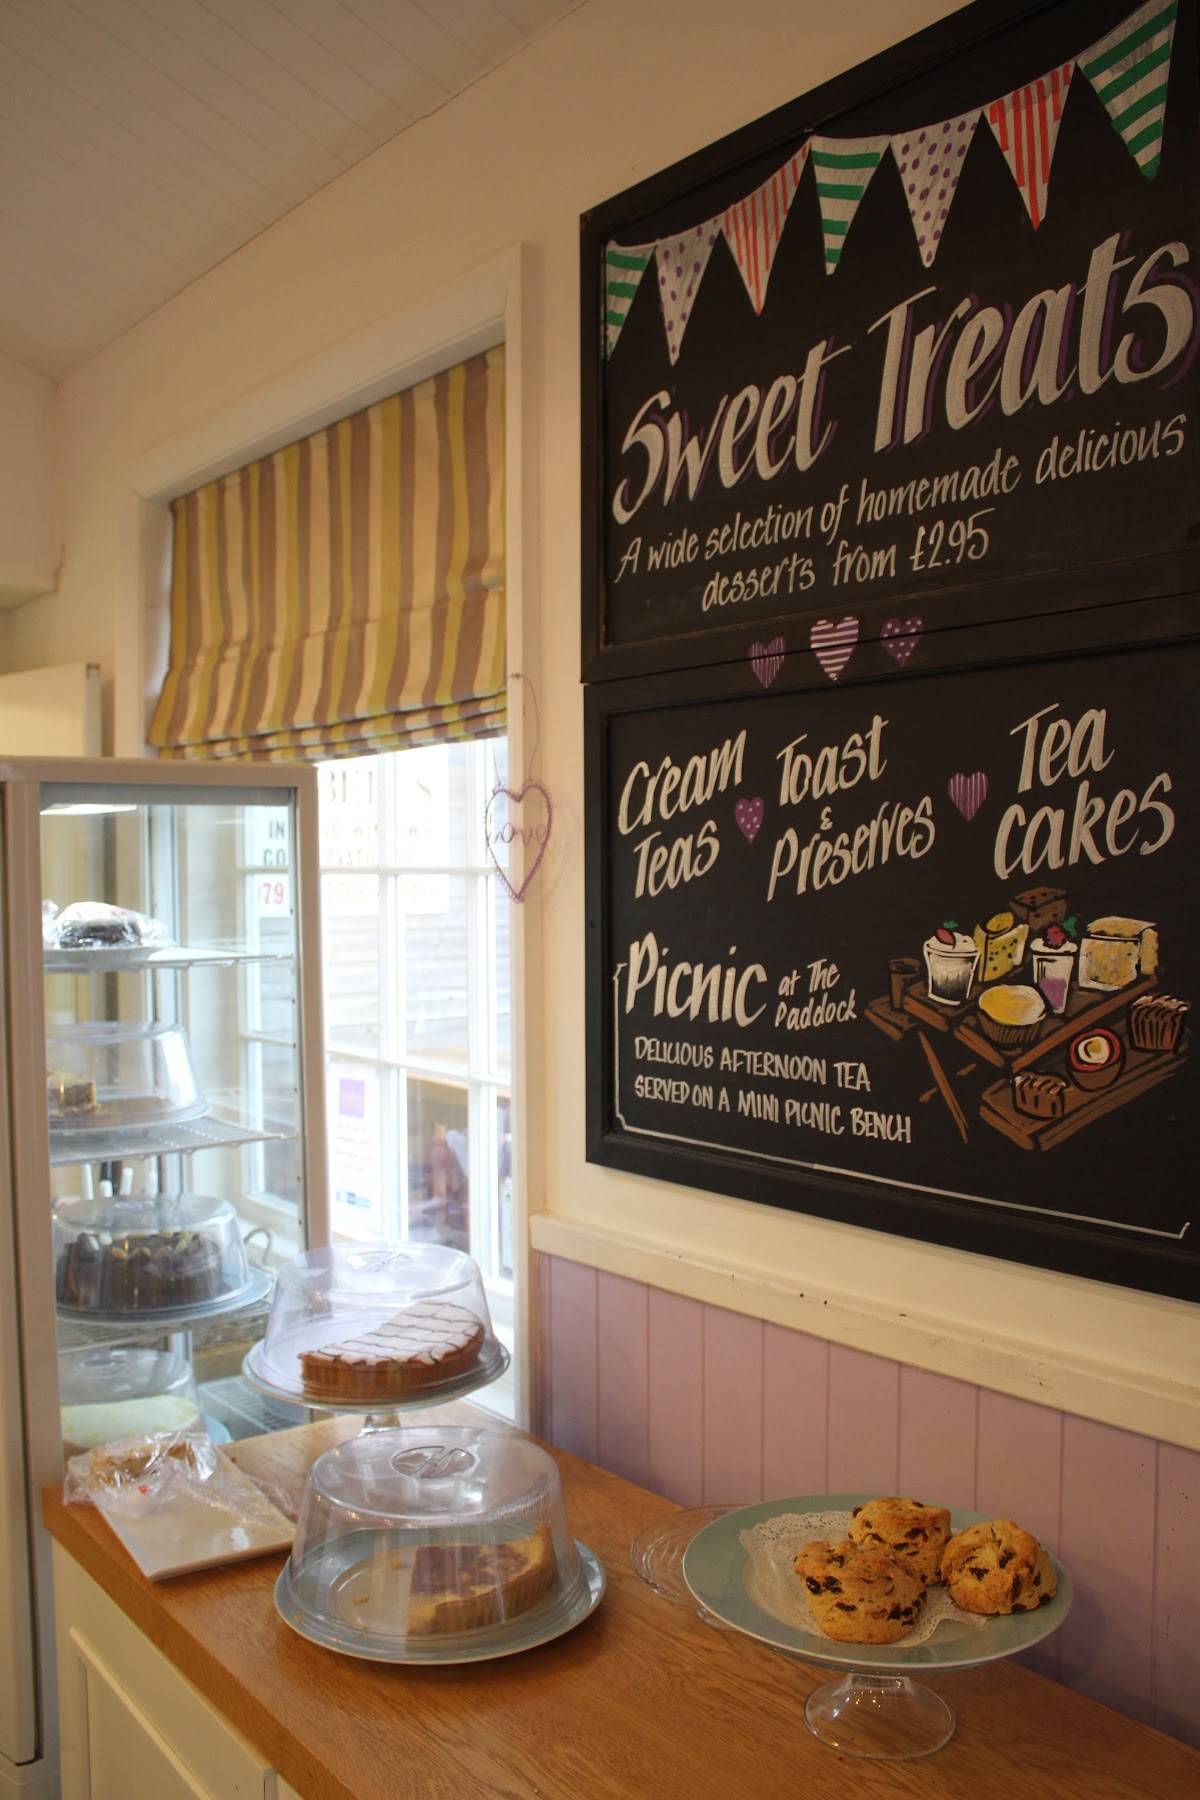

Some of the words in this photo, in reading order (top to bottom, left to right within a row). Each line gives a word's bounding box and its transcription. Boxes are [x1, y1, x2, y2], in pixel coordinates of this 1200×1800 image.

[612, 338, 852, 525] Sweet
[867, 232, 1194, 454] Treats
[614, 536, 642, 583] A
[647, 527, 700, 572] wide
[704, 504, 814, 562] selection
[820, 484, 850, 546] of
[856, 447, 1023, 526] homemade
[1035, 413, 1187, 485] delicious
[702, 552, 816, 612] desserts
[832, 539, 897, 587] from
[909, 507, 997, 573] £2.95
[617, 729, 747, 836] Cream
[775, 714, 890, 807] Toast
[1009, 702, 1116, 794] Tea
[633, 819, 721, 899] Teas
[766, 795, 937, 902] Preserves
[625, 931, 769, 1029] Picnic
[774, 988, 858, 1031] Paddock
[778, 969, 802, 997] at
[806, 958, 841, 994] The
[634, 1035, 715, 1069] DELICIOUS
[719, 1046, 828, 1086] AFTERNOON
[833, 1061, 872, 1092] TEA
[634, 1074, 691, 1105] SERVED
[691, 1084, 714, 1110] ON
[717, 1086, 731, 1113] A
[737, 1089, 780, 1124] MINI
[784, 1099, 846, 1136] PICNIC
[849, 1106, 912, 1144] BENCH
